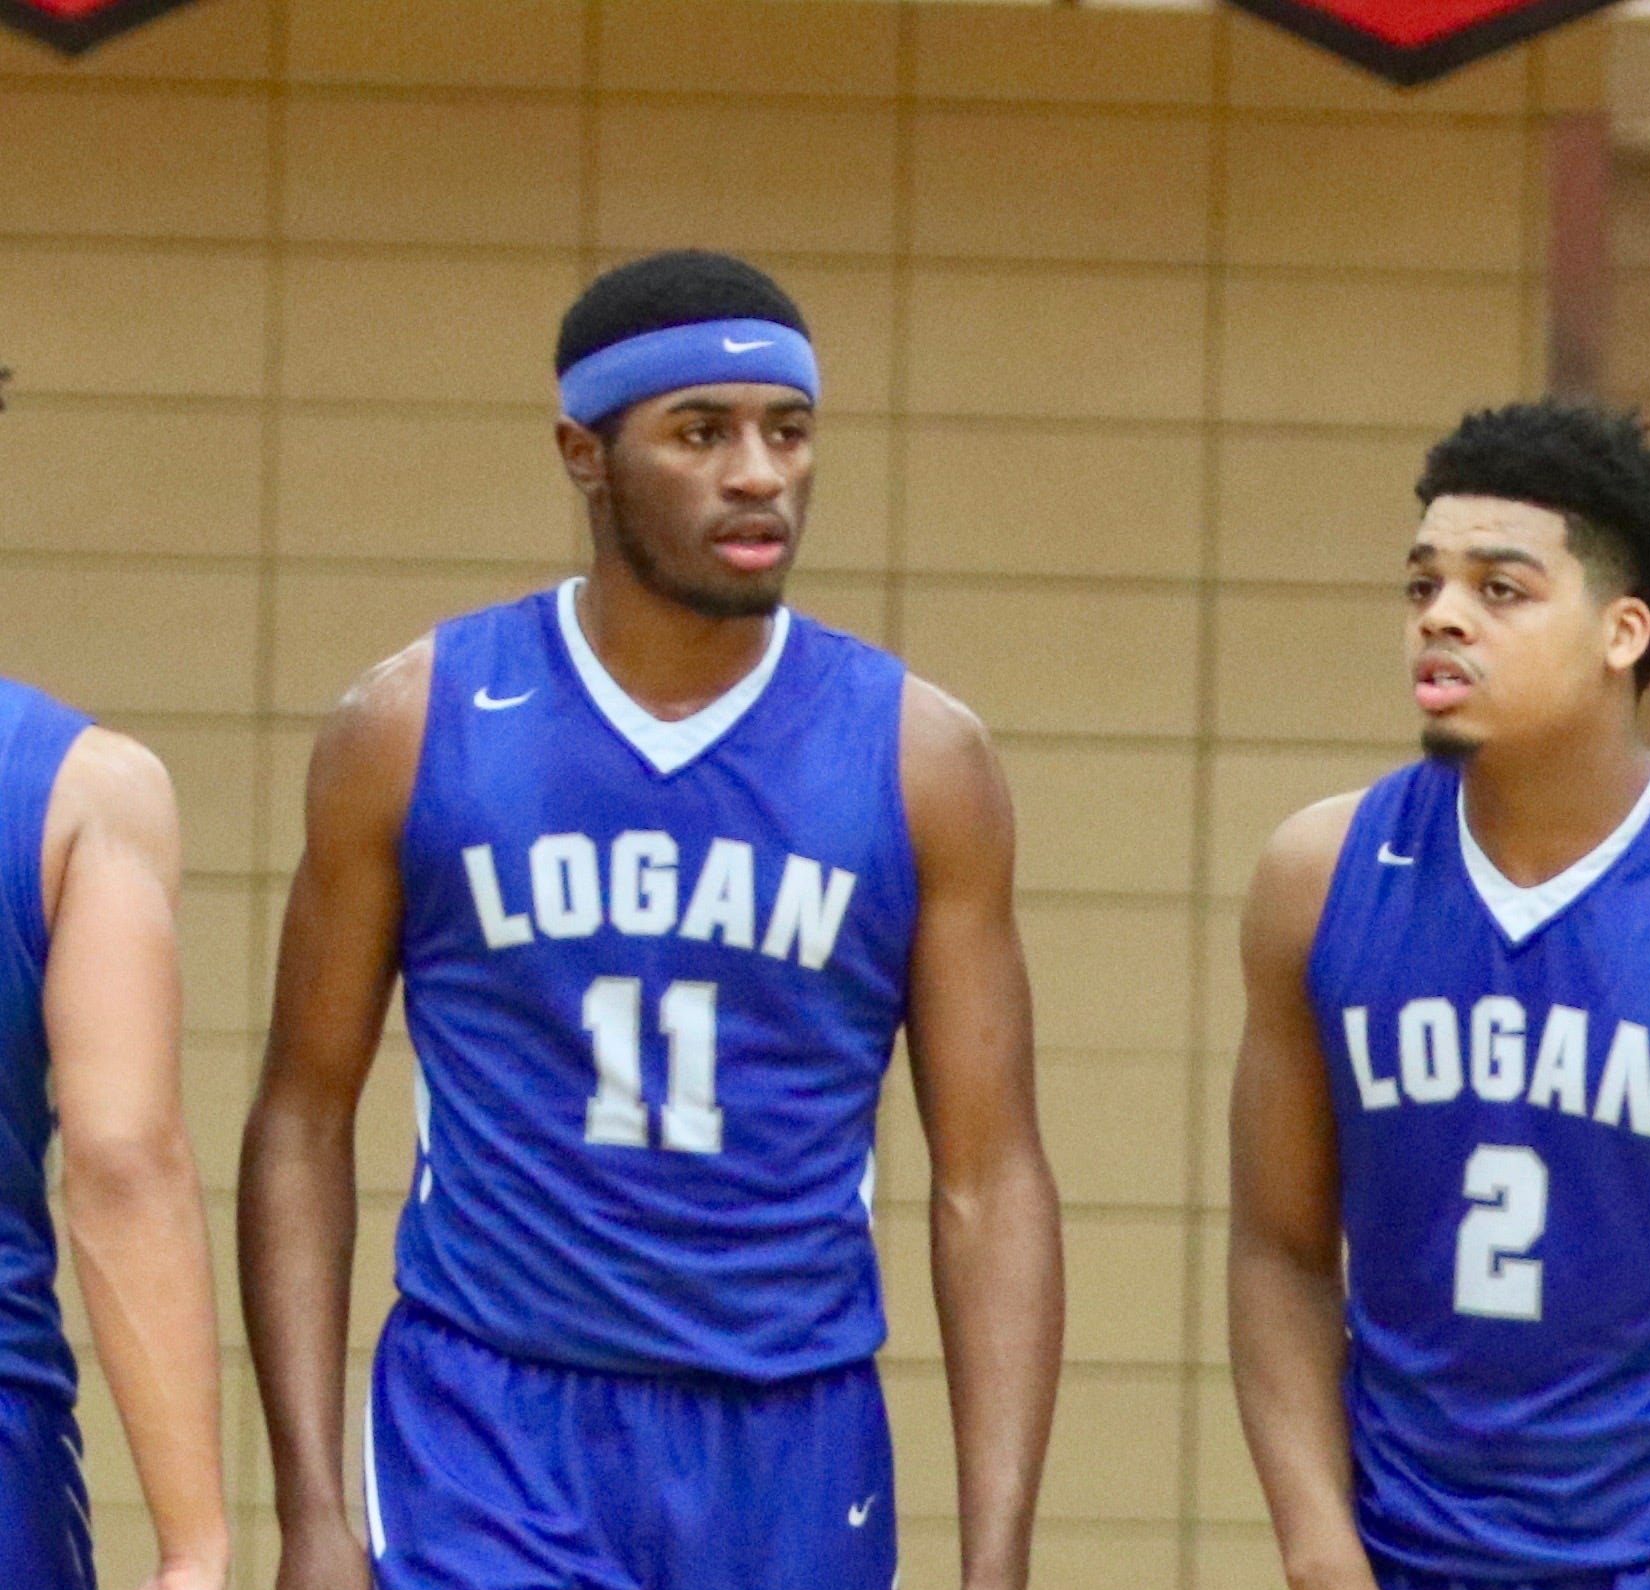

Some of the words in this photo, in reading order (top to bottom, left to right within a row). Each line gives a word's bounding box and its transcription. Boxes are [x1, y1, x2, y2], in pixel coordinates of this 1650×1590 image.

[462, 829, 857, 970] LOGAN
[581, 975, 723, 1154] 11
[1453, 1142, 1550, 1323] 2
